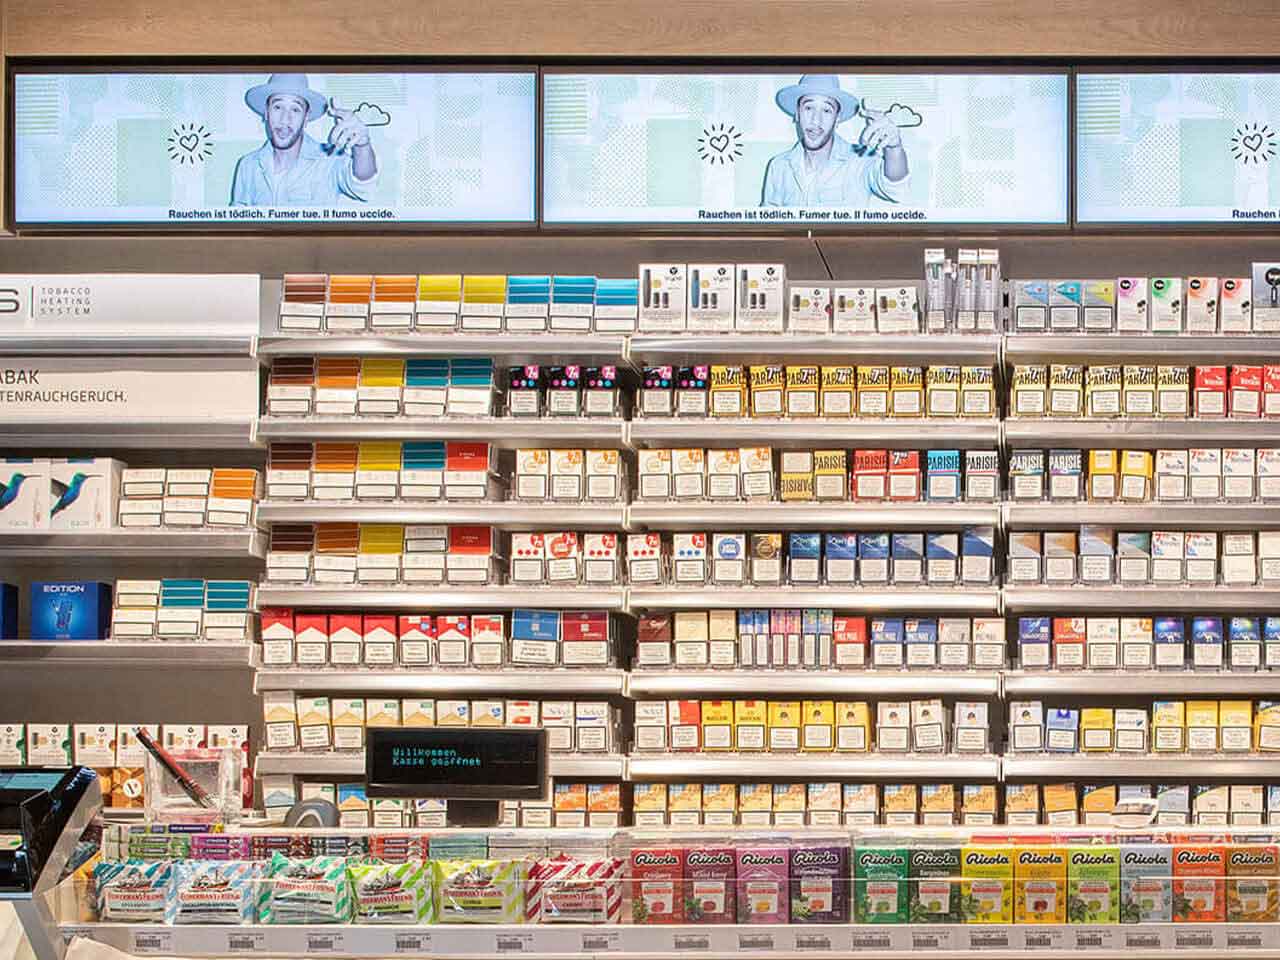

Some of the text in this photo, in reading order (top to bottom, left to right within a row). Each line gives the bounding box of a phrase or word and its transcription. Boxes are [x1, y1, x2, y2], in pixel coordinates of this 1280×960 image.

[168, 209, 396, 219] Rauchen ist tödlich. Fumer tue. fumo uccide.
[698, 210, 927, 220] Rauchen ist tödlich. Fumer tue. fumo uccide.
[1232, 209, 1276, 219] Rauchen
[41, 287, 91, 295] TOBACCO
[41, 297, 91, 305] HEATING
[41, 307, 91, 315] SYSTEM
[43, 584, 85, 593] EDITION
[392, 747, 457, 757] Willkommen
[392, 757, 482, 767] Kasse geöffnet
[635, 852, 679, 865] Ricola
[687, 852, 733, 865] Ricola
[740, 852, 785, 865] Ricola
[794, 852, 839, 865] Ricola
[860, 852, 905, 865] Ricola
[911, 852, 959, 865] Ricola
[966, 852, 1010, 865] Ricola
[1019, 851, 1063, 865] Ricola
[1071, 852, 1116, 865] Ricola
[1124, 852, 1168, 865] Ricola
[1177, 851, 1221, 864] Ricola
[1231, 852, 1275, 865] Ricola
